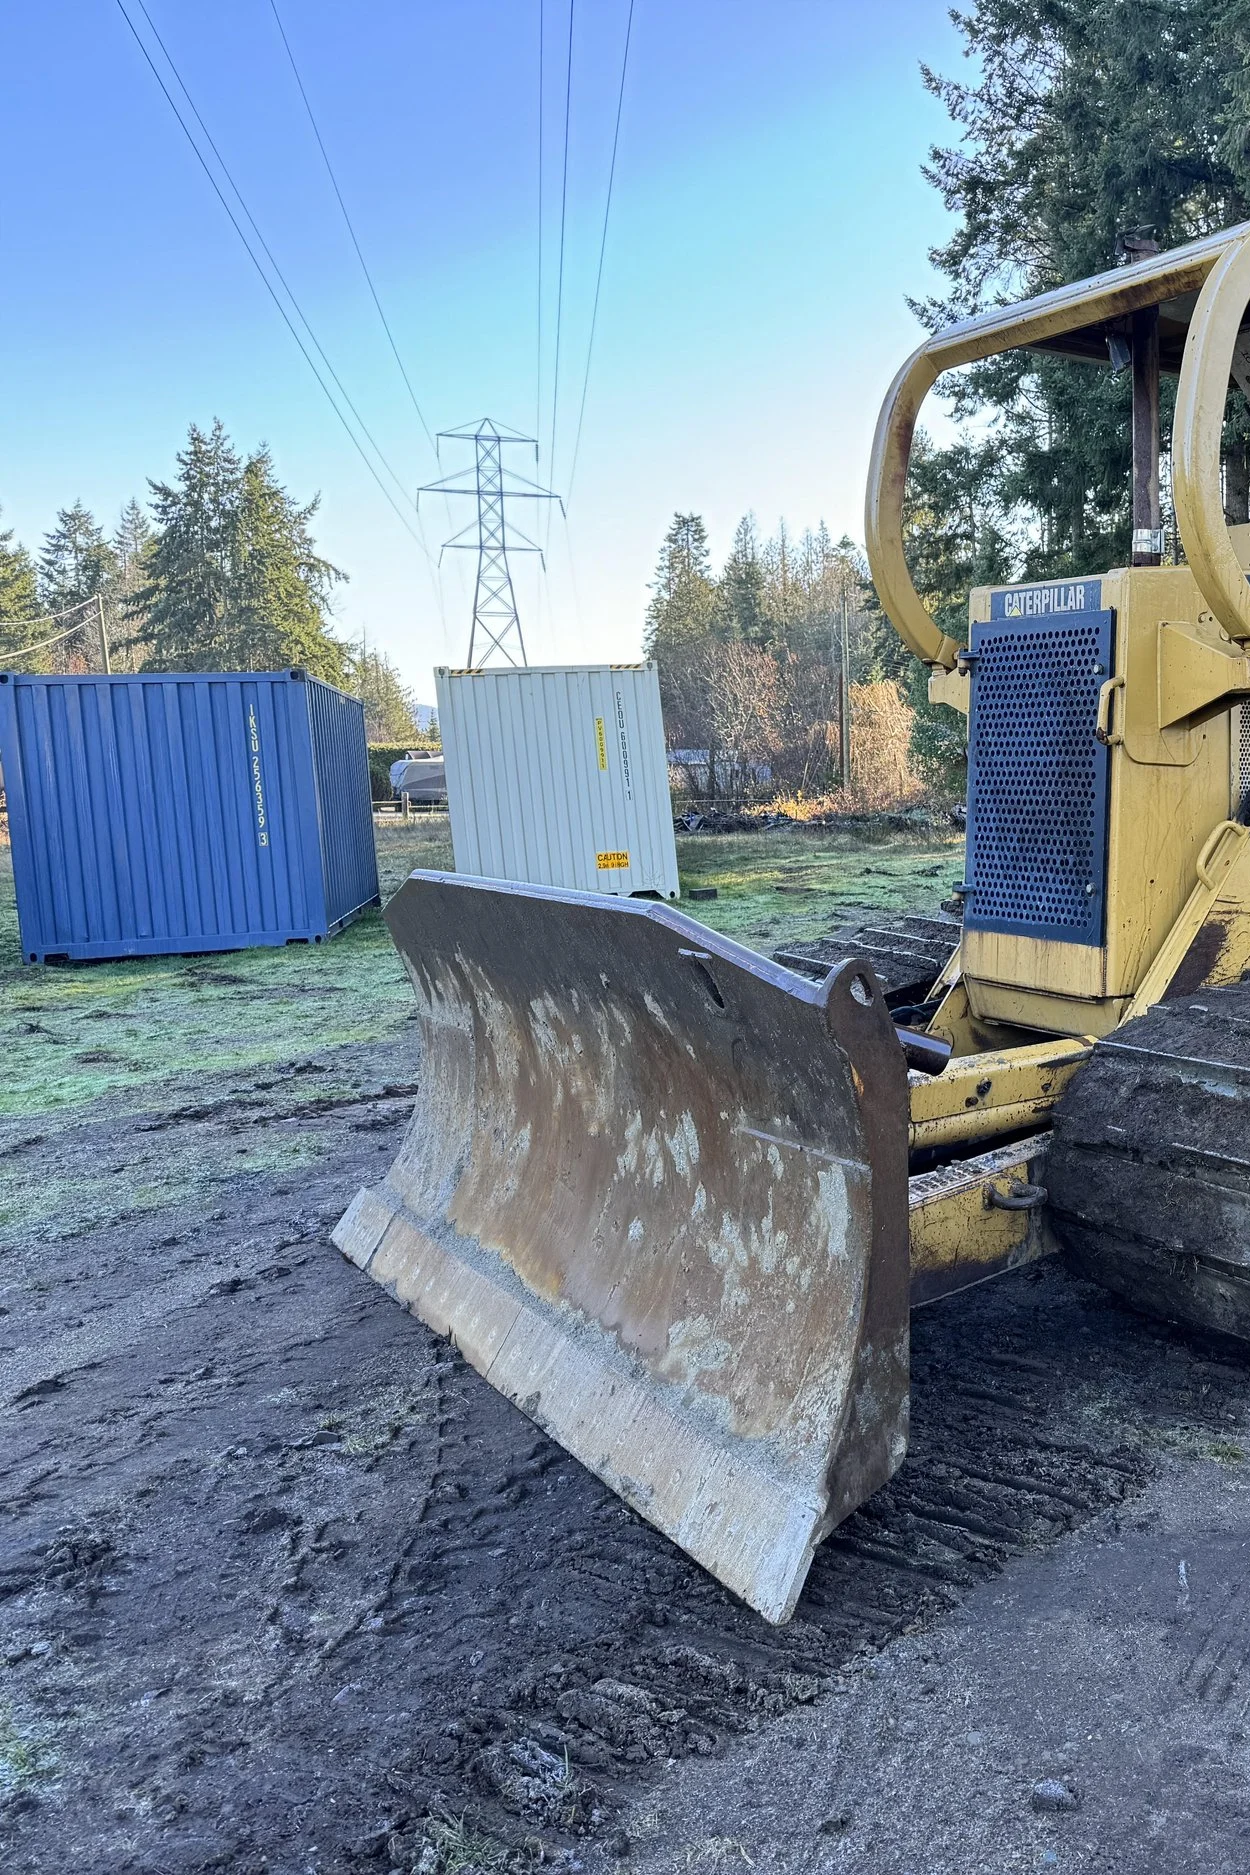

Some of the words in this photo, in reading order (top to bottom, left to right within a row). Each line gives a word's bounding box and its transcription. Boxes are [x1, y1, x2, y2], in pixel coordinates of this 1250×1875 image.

[1005, 585, 1085, 617] CATERPILLAR
[249, 703, 259, 752] IKSU
[620, 732, 630, 787] 600991
[252, 756, 265, 828] 256359
[260, 833, 267, 846] 3
[597, 852, 628, 862] CAUTON
